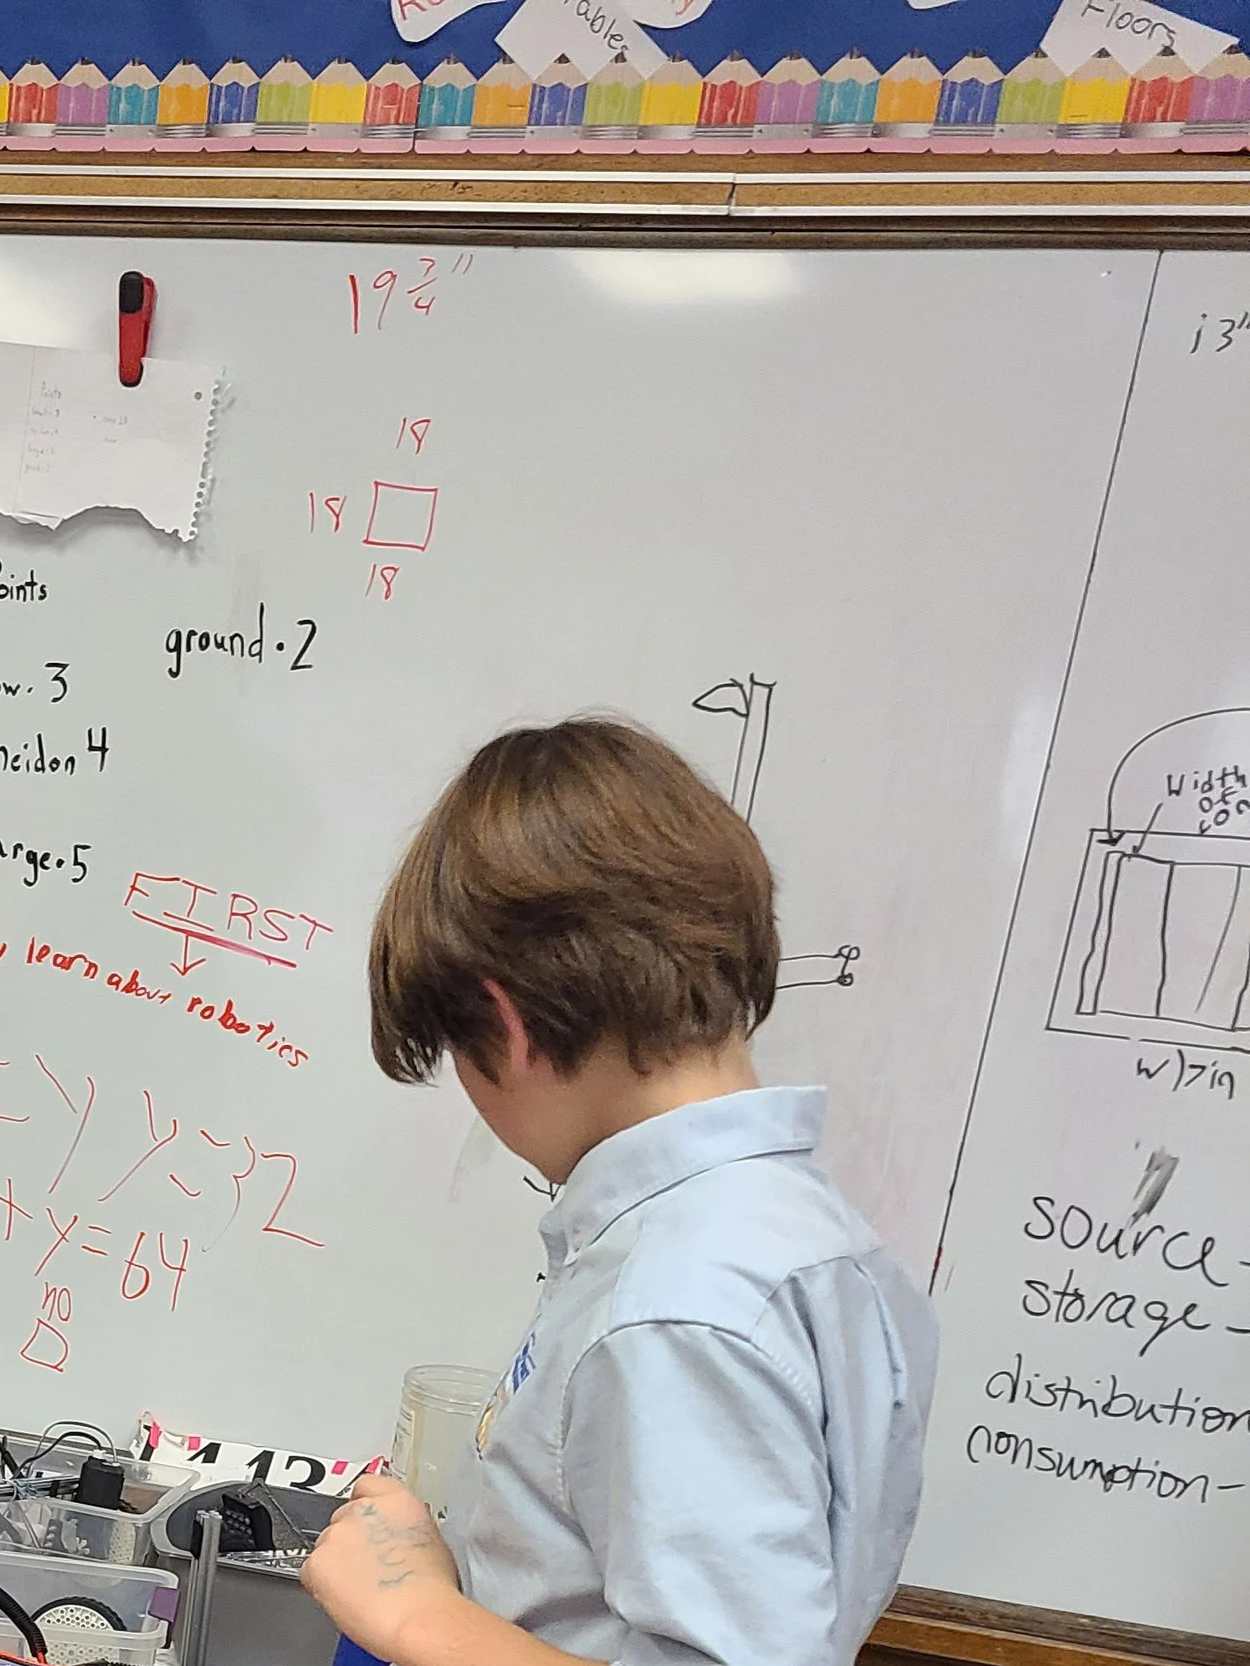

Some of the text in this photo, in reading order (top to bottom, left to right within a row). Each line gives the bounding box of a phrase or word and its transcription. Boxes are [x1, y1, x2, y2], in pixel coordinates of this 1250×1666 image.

[563, 0, 630, 51] ables
[395, 416, 432, 455] 18
[308, 491, 348, 533] 18
[364, 563, 400, 601] 18
[86, 726, 110, 773] 4
[1166, 764, 1248, 797] Width
[124, 870, 335, 951] FIRST
[25, 935, 100, 981] learn
[105, 964, 172, 1006] about
[186, 993, 310, 1069] robotics
[120, 1230, 190, 1312] 64
[43, 1281, 72, 1323] no
[985, 1352, 1250, 1435] distribution
